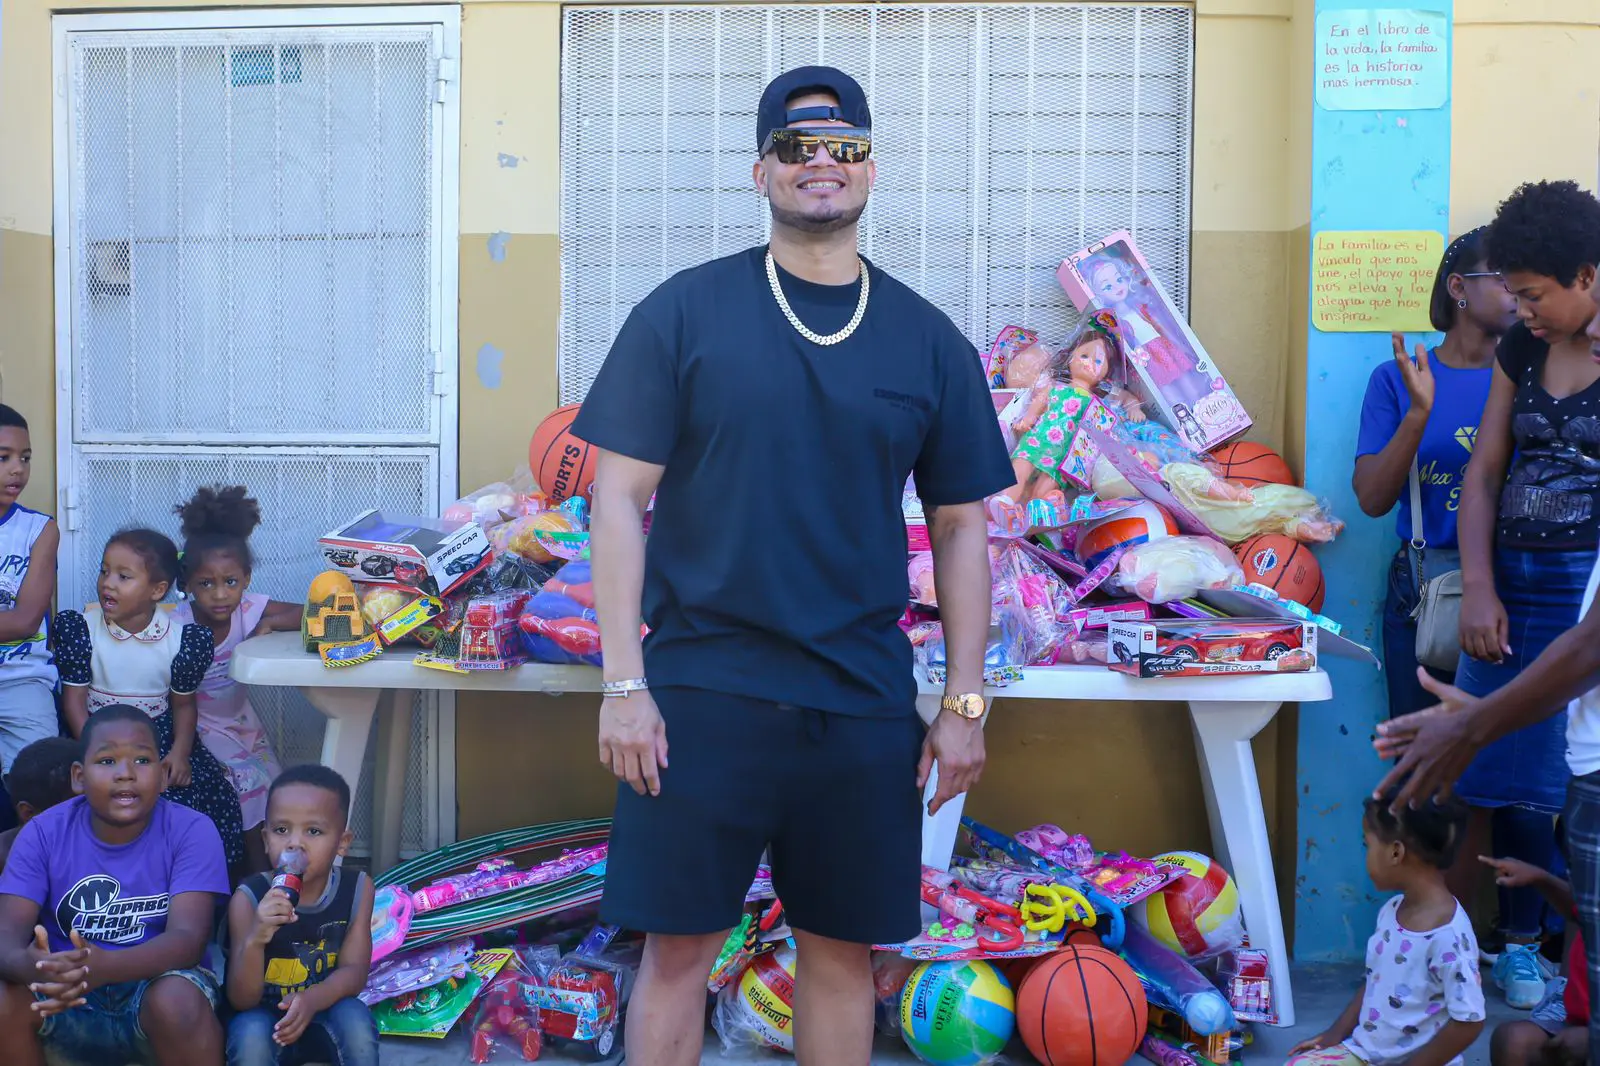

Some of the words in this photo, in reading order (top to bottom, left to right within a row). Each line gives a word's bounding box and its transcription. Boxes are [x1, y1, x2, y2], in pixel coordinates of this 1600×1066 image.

[1331, 24, 1349, 37] En
[1357, 25, 1369, 35] el
[1415, 24, 1430, 34] de
[1326, 43, 1338, 55] la
[1381, 41, 1392, 53] la
[1397, 41, 1438, 53] familia
[1324, 63, 1340, 73] es
[1347, 60, 1360, 73] la
[1366, 58, 1423, 72] historia
[1323, 79, 1349, 88] mas
[1394, 242, 1409, 251] es
[1416, 238, 1428, 251] el
[1370, 256, 1391, 268] que
[1396, 256, 1418, 264] nos
[1350, 268, 1361, 279] el
[1409, 269, 1433, 283] que
[1317, 283, 1340, 292] nos
[1349, 282, 1387, 293] eleva
[1370, 299, 1391, 310] que
[1398, 300, 1420, 308] nos
[551, 444, 580, 501] PORTS
[1144, 657, 1184, 666] FAST
[84, 914, 133, 931] Flag
